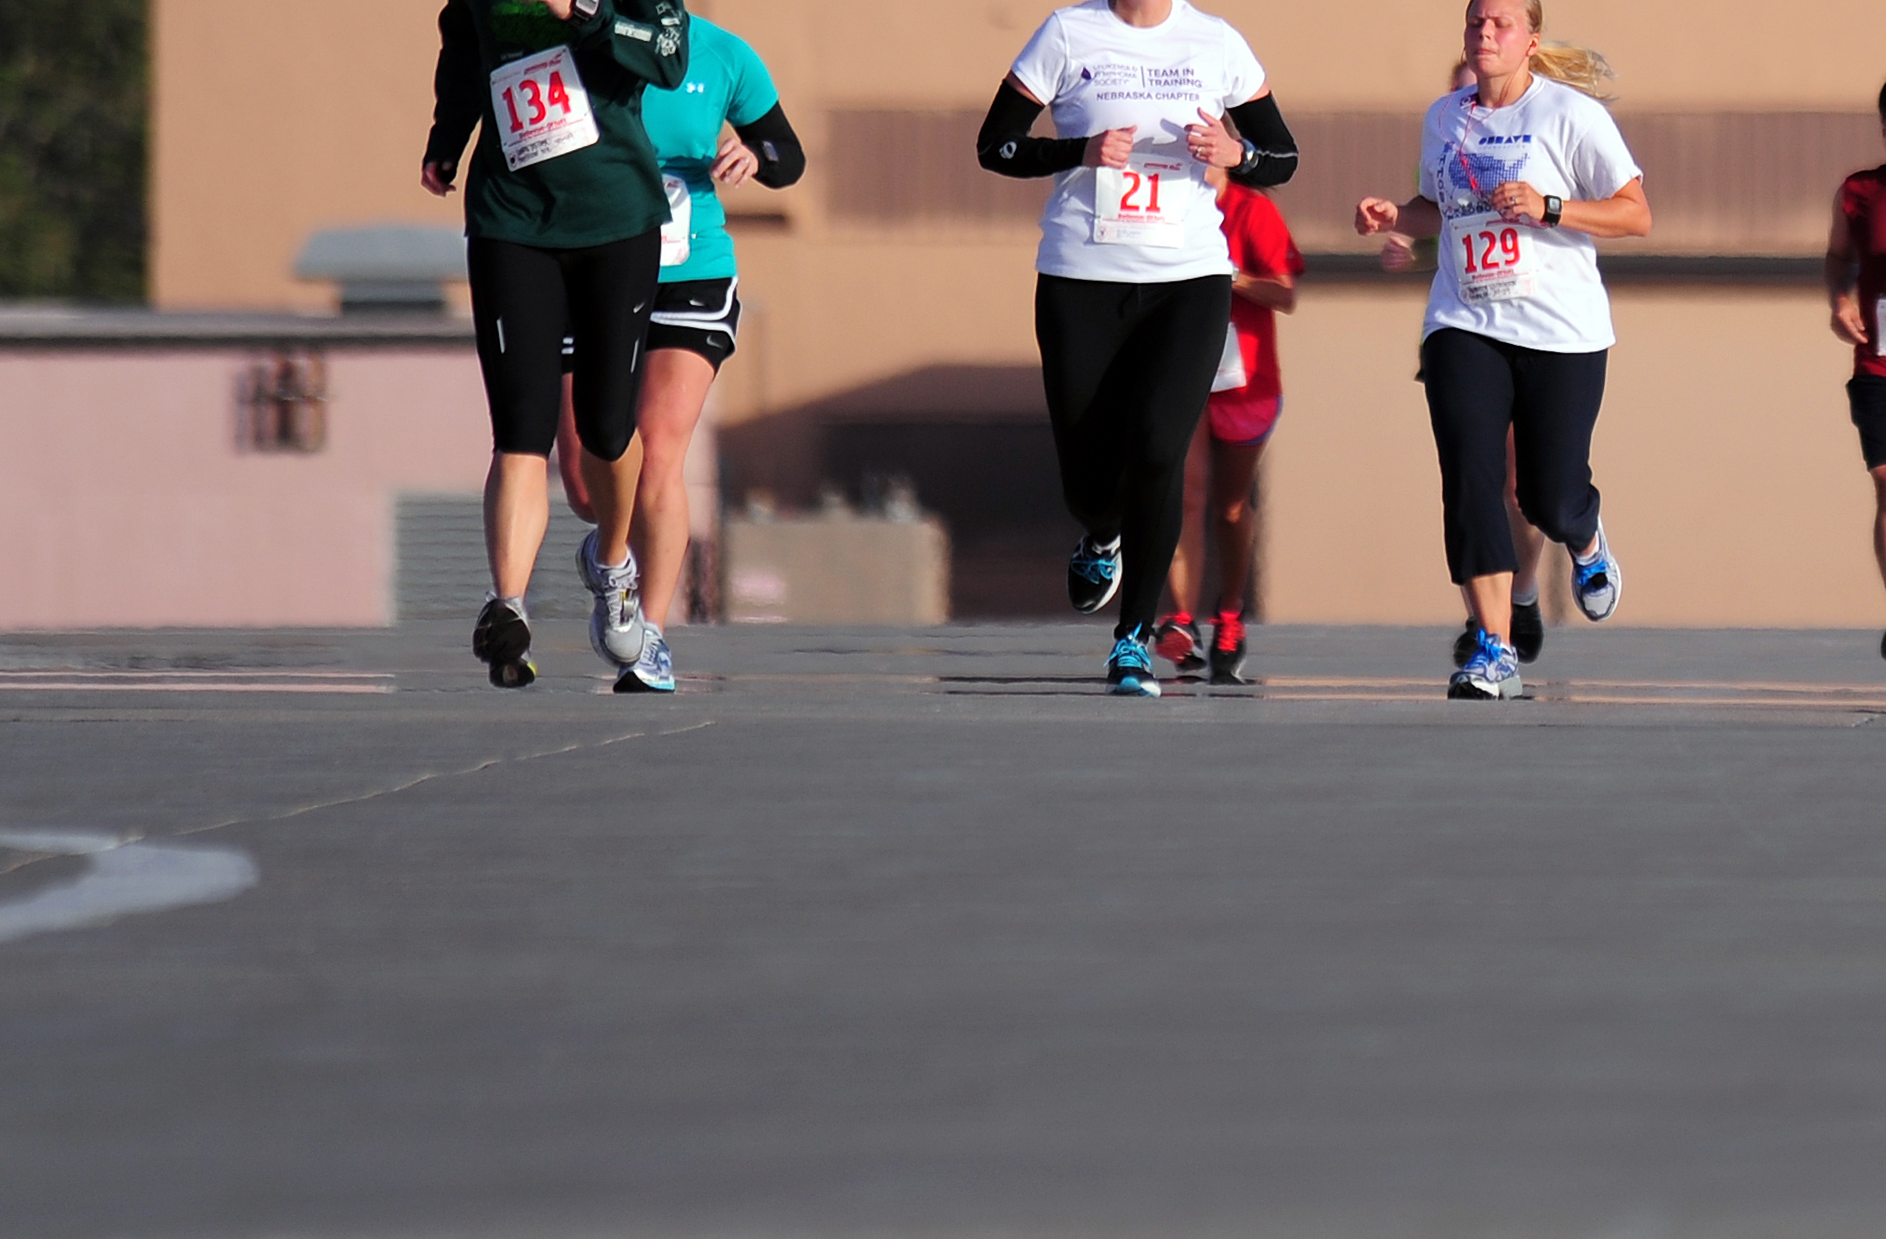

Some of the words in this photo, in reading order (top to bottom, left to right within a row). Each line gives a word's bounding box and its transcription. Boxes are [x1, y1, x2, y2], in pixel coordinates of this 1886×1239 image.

[1147, 68, 1179, 78] TEAM
[1182, 67, 1195, 77] IN
[1094, 78, 1130, 87] SOCIETY
[1148, 78, 1203, 89] TRAINING
[502, 70, 572, 133] 134
[1096, 91, 1152, 101] NEBRASKA
[1155, 92, 1200, 101] CHAPTER
[1120, 171, 1161, 213] 21
[1462, 227, 1521, 274] 129
